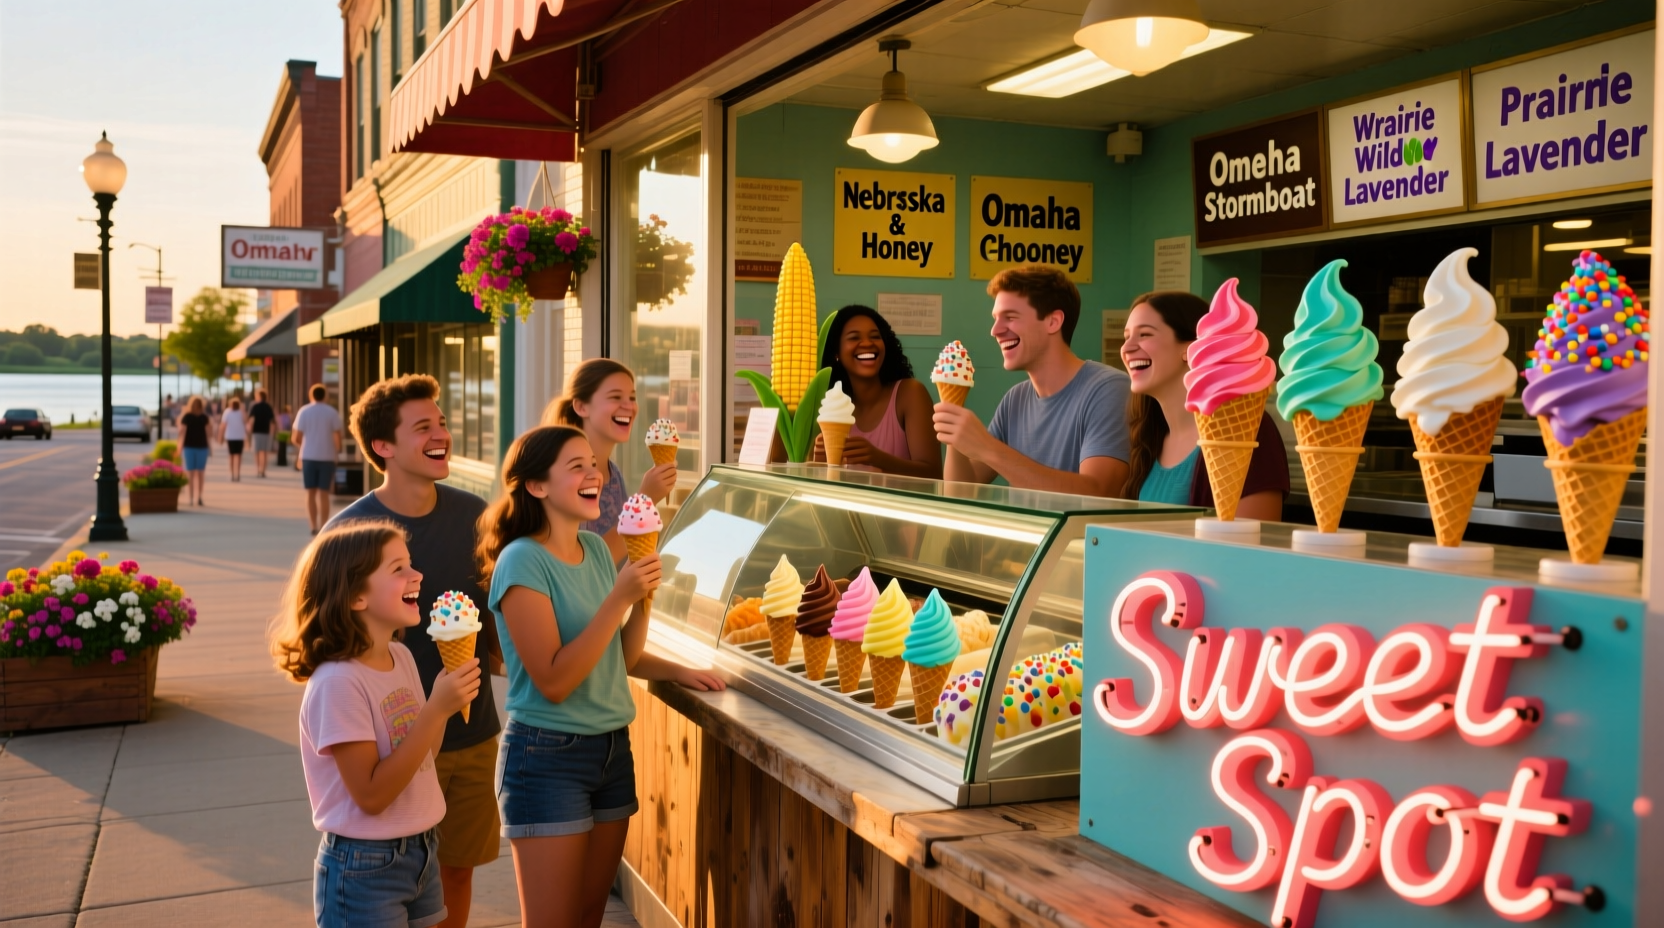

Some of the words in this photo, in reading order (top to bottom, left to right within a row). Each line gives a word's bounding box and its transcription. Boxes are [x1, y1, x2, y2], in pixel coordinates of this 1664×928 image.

[1353, 100, 1435, 143] Wrairie
[1209, 139, 1301, 187] Omeha
[1485, 119, 1648, 179] Lavender
[843, 181, 945, 213] Nebrsska
[1204, 177, 1316, 222] Stormboat
[1344, 165, 1449, 206] Lavender
[889, 213, 906, 235] &
[981, 193, 1080, 231] Omaha
[862, 231, 933, 268] Honey
[1094, 570, 1544, 746] Sweet
[1188, 729, 1593, 928] Spot
